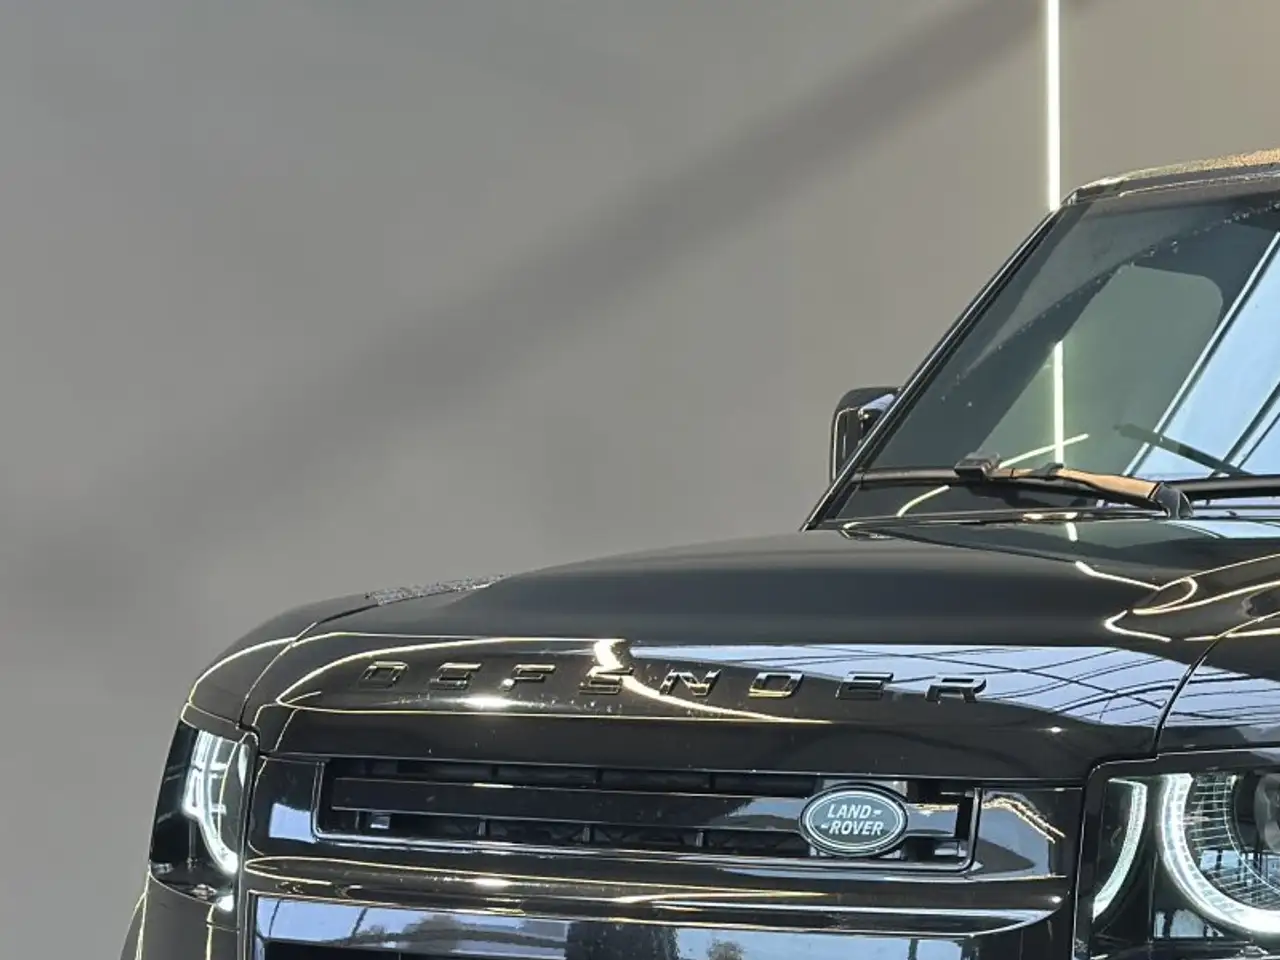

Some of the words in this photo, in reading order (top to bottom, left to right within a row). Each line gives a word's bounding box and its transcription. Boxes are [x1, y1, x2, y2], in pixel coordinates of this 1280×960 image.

[358, 661, 987, 704] DEFENDER
[827, 803, 872, 819] LAND
[828, 820, 885, 835] ROVER
